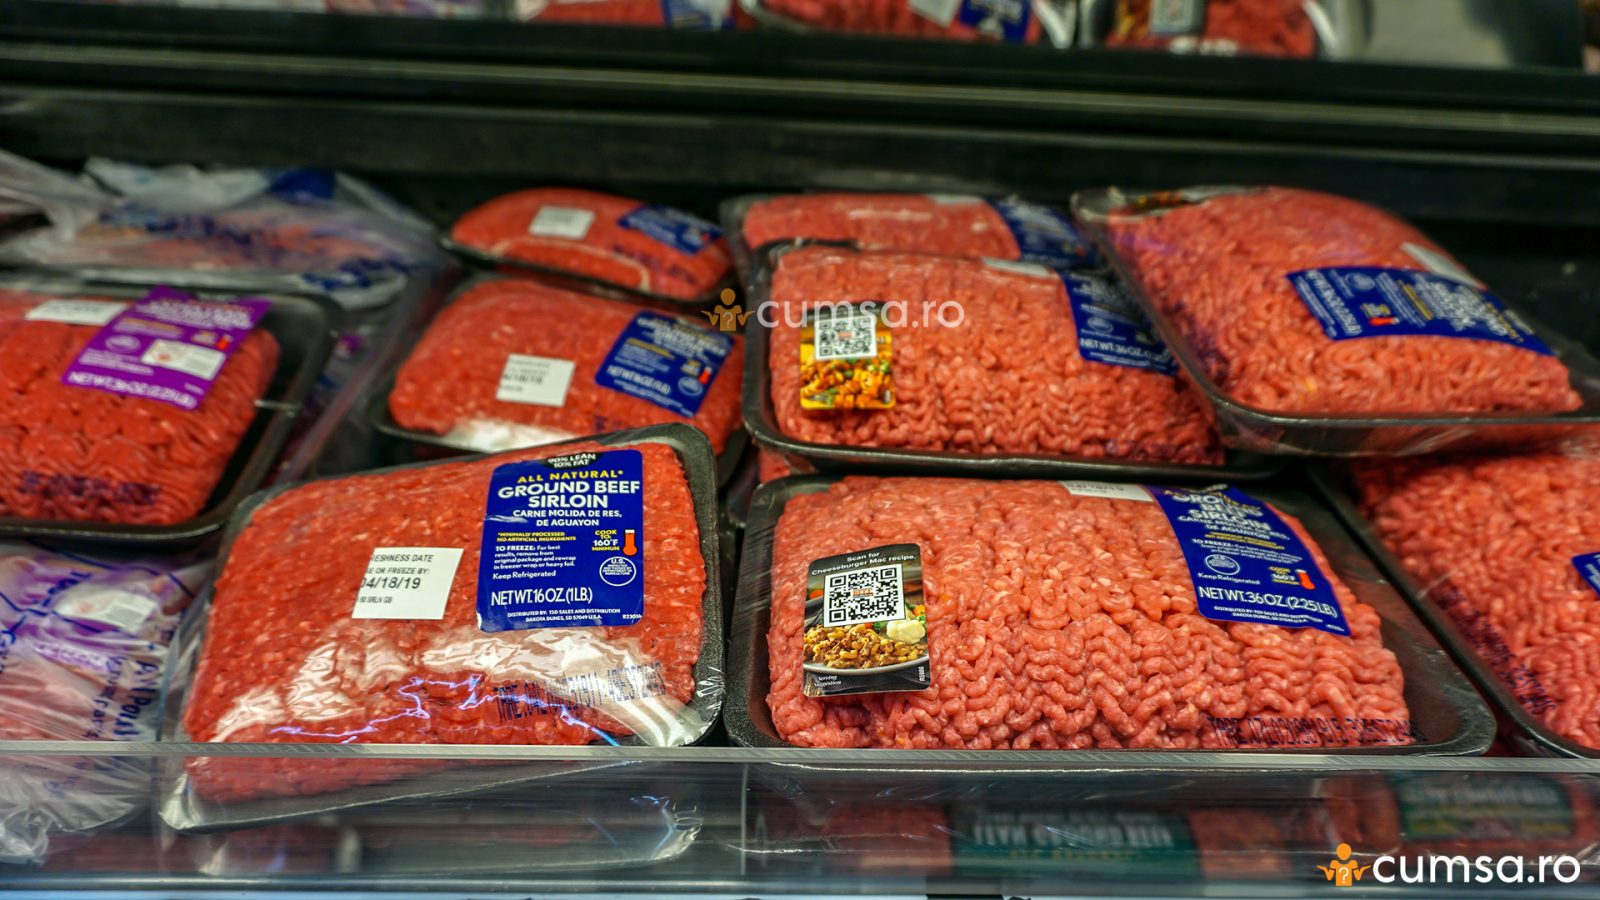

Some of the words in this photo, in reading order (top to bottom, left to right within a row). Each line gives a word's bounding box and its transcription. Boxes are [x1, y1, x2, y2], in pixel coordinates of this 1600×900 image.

[570, 453, 596, 461] LEAN
[573, 459, 589, 467] FAT
[517, 474, 544, 483] ALL
[498, 481, 590, 499] GROUND
[594, 480, 641, 494] BEEF
[528, 494, 608, 508] SIRLOIN
[513, 509, 547, 518] CARNE
[548, 509, 586, 517] MOLIDA
[588, 509, 601, 517] DE
[602, 509, 622, 518] RES,
[536, 519, 549, 527] DE
[550, 519, 600, 527] AGUAYON
[1188, 509, 1271, 531] SIRLOIN
[411, 554, 435, 562] DATE
[516, 556, 543, 564] package
[846, 554, 867, 562] Scan
[811, 561, 868, 575] Cheeseburger
[869, 556, 887, 564] Mac
[888, 554, 917, 562] recipe.
[387, 567, 416, 575] FREEZE
[417, 567, 430, 575] BY:
[492, 572, 512, 580] Keep
[512, 570, 557, 579] Refrigerated
[1198, 572, 1219, 581] Keep
[1219, 574, 1261, 585] Refrigerated
[491, 590, 514, 606] NET
[514, 588, 533, 604] WT.
[533, 588, 545, 603] 16
[545, 587, 566, 603] OZ.
[1198, 586, 1224, 600] NET
[1224, 589, 1247, 602] WT.
[1247, 591, 1264, 605] 36
[507, 610, 539, 618] DISTRIBUTED
